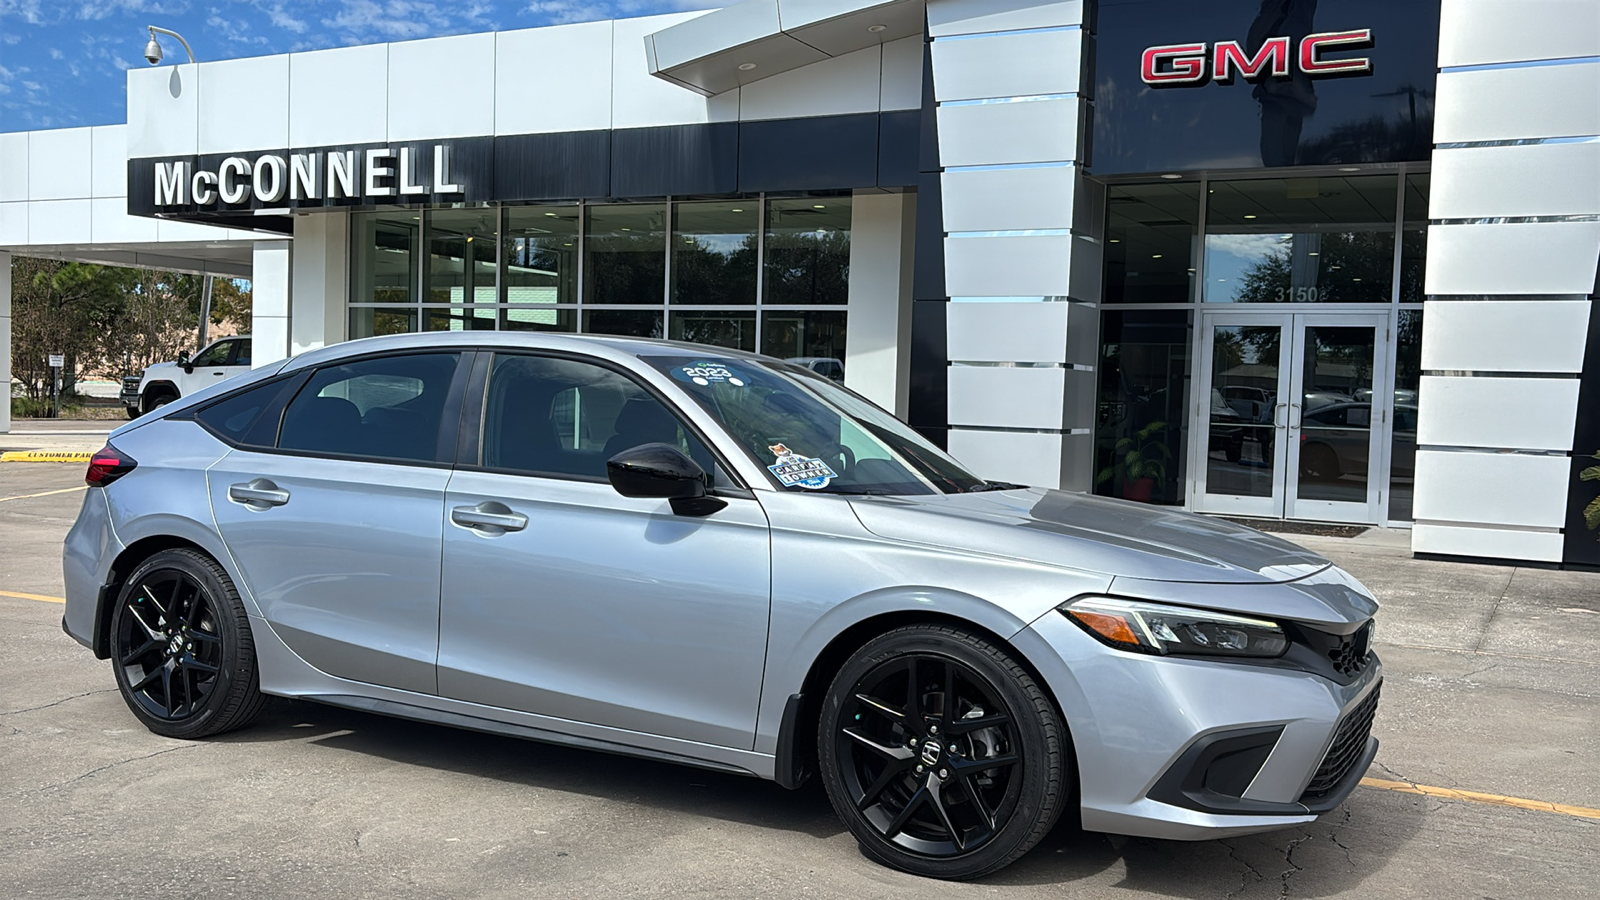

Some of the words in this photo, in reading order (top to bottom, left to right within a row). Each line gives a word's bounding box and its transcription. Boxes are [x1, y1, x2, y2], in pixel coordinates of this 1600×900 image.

[1141, 28, 1372, 86] GMC
[154, 144, 464, 207] McCONNELL
[1274, 286, 1318, 302] 3150
[682, 367, 732, 378] 2023
[775, 462, 823, 475] CARFAX
